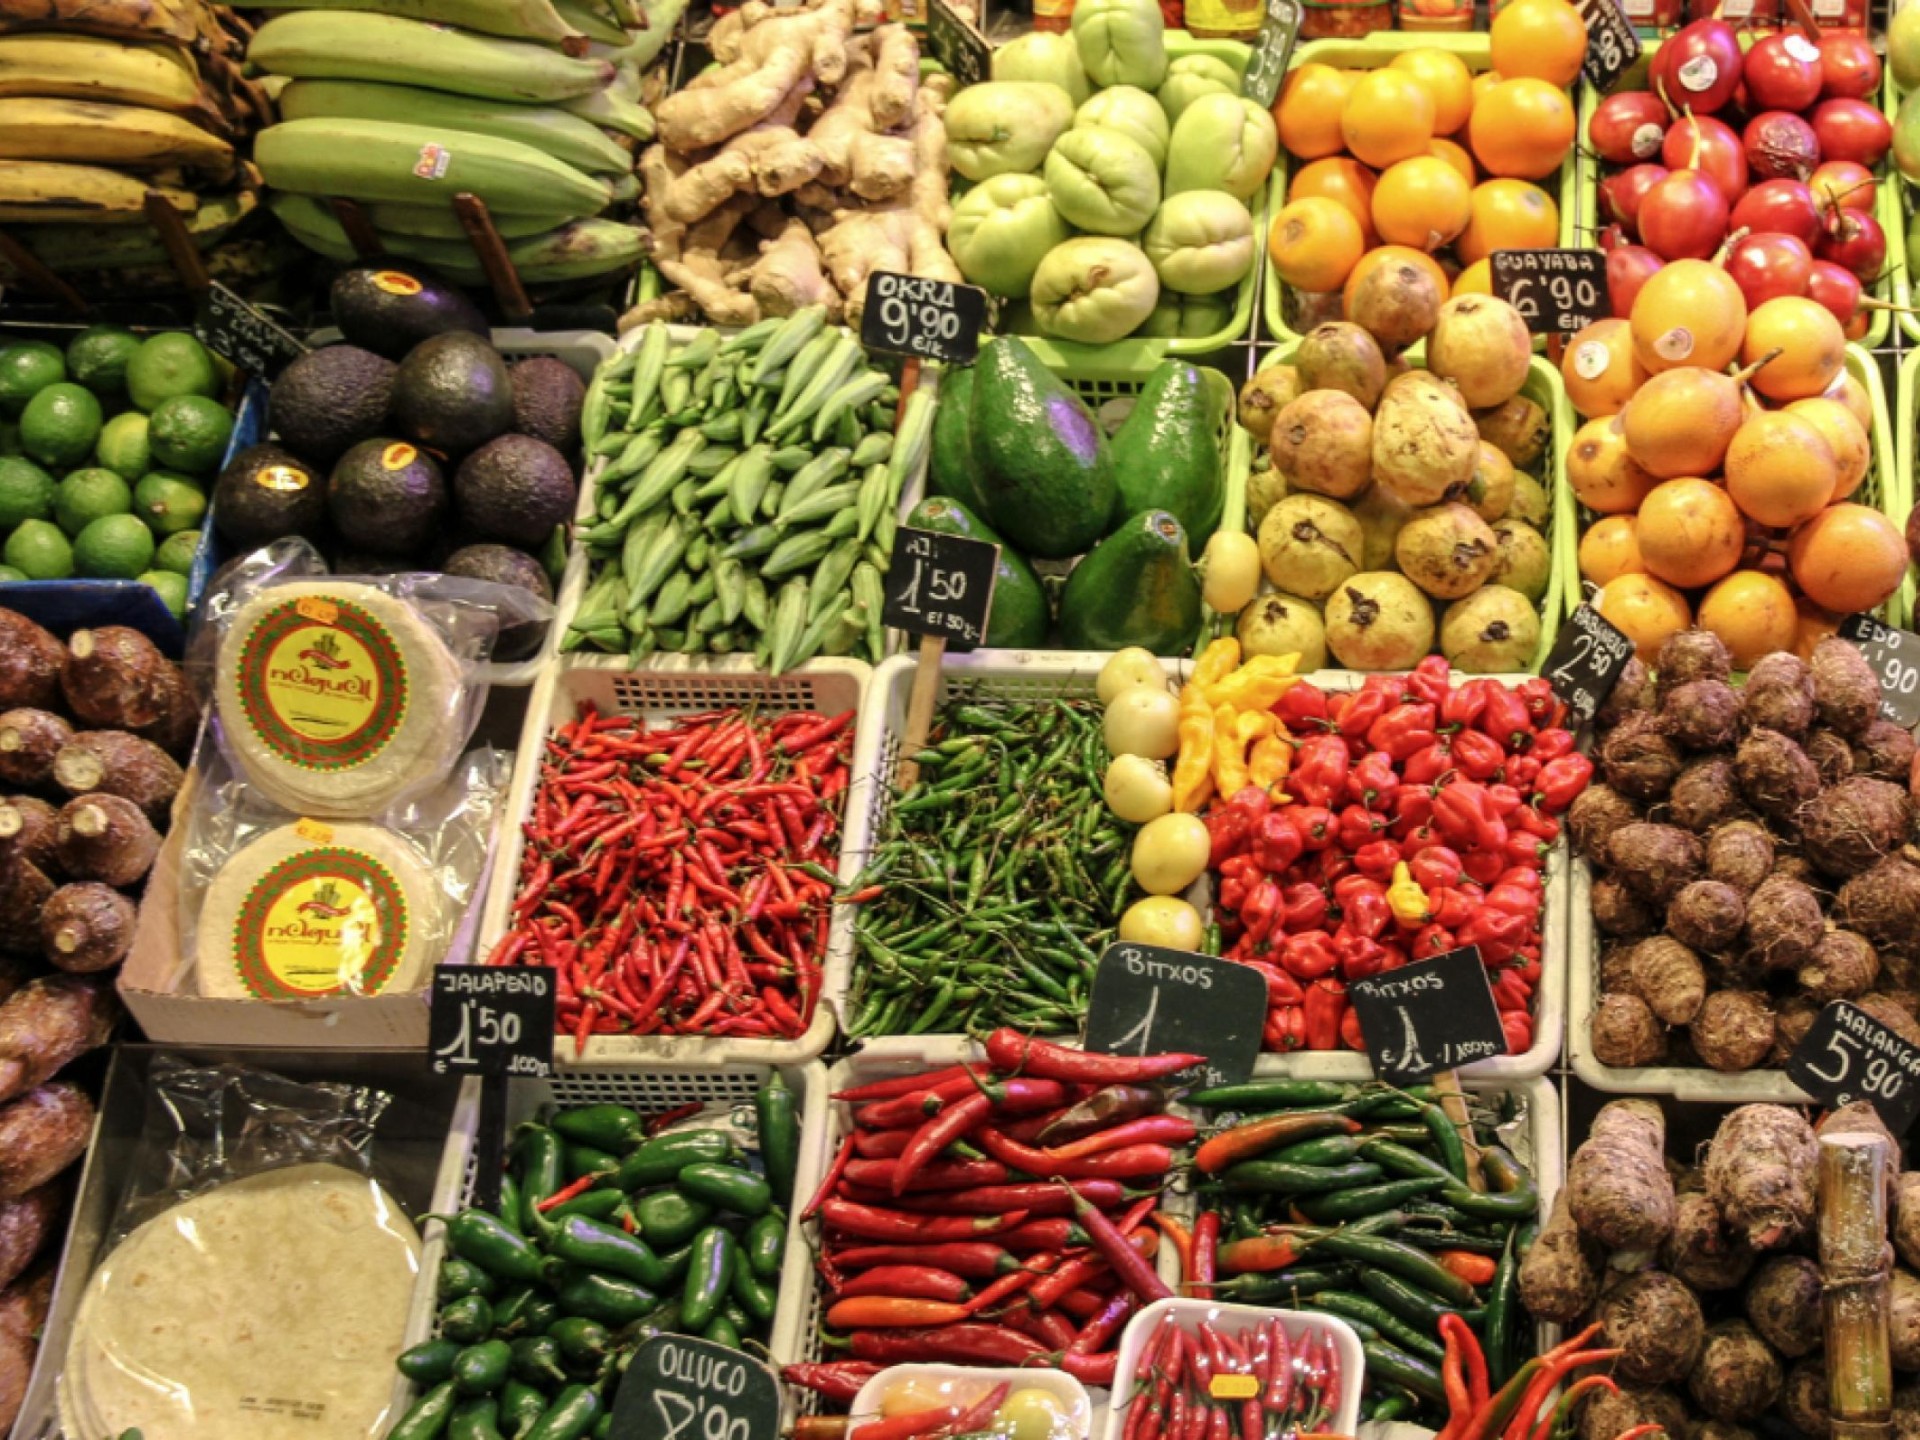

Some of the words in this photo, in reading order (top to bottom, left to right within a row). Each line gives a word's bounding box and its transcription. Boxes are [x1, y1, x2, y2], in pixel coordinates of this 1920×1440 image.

[1495, 253, 1594, 271] GUAYABA
[877, 275, 955, 308] OKRA
[1509, 276, 1597, 317] 6'90
[881, 297, 960, 345] 9'90
[896, 558, 968, 613] 1'50
[1551, 634, 1612, 683] 2'50
[1856, 620, 1901, 649] EDO
[435, 999, 521, 1064] 1'50
[1836, 1005, 1920, 1077] MALANGA
[1805, 1029, 1904, 1099] 5'90
[659, 1344, 747, 1397] OLLUCO
